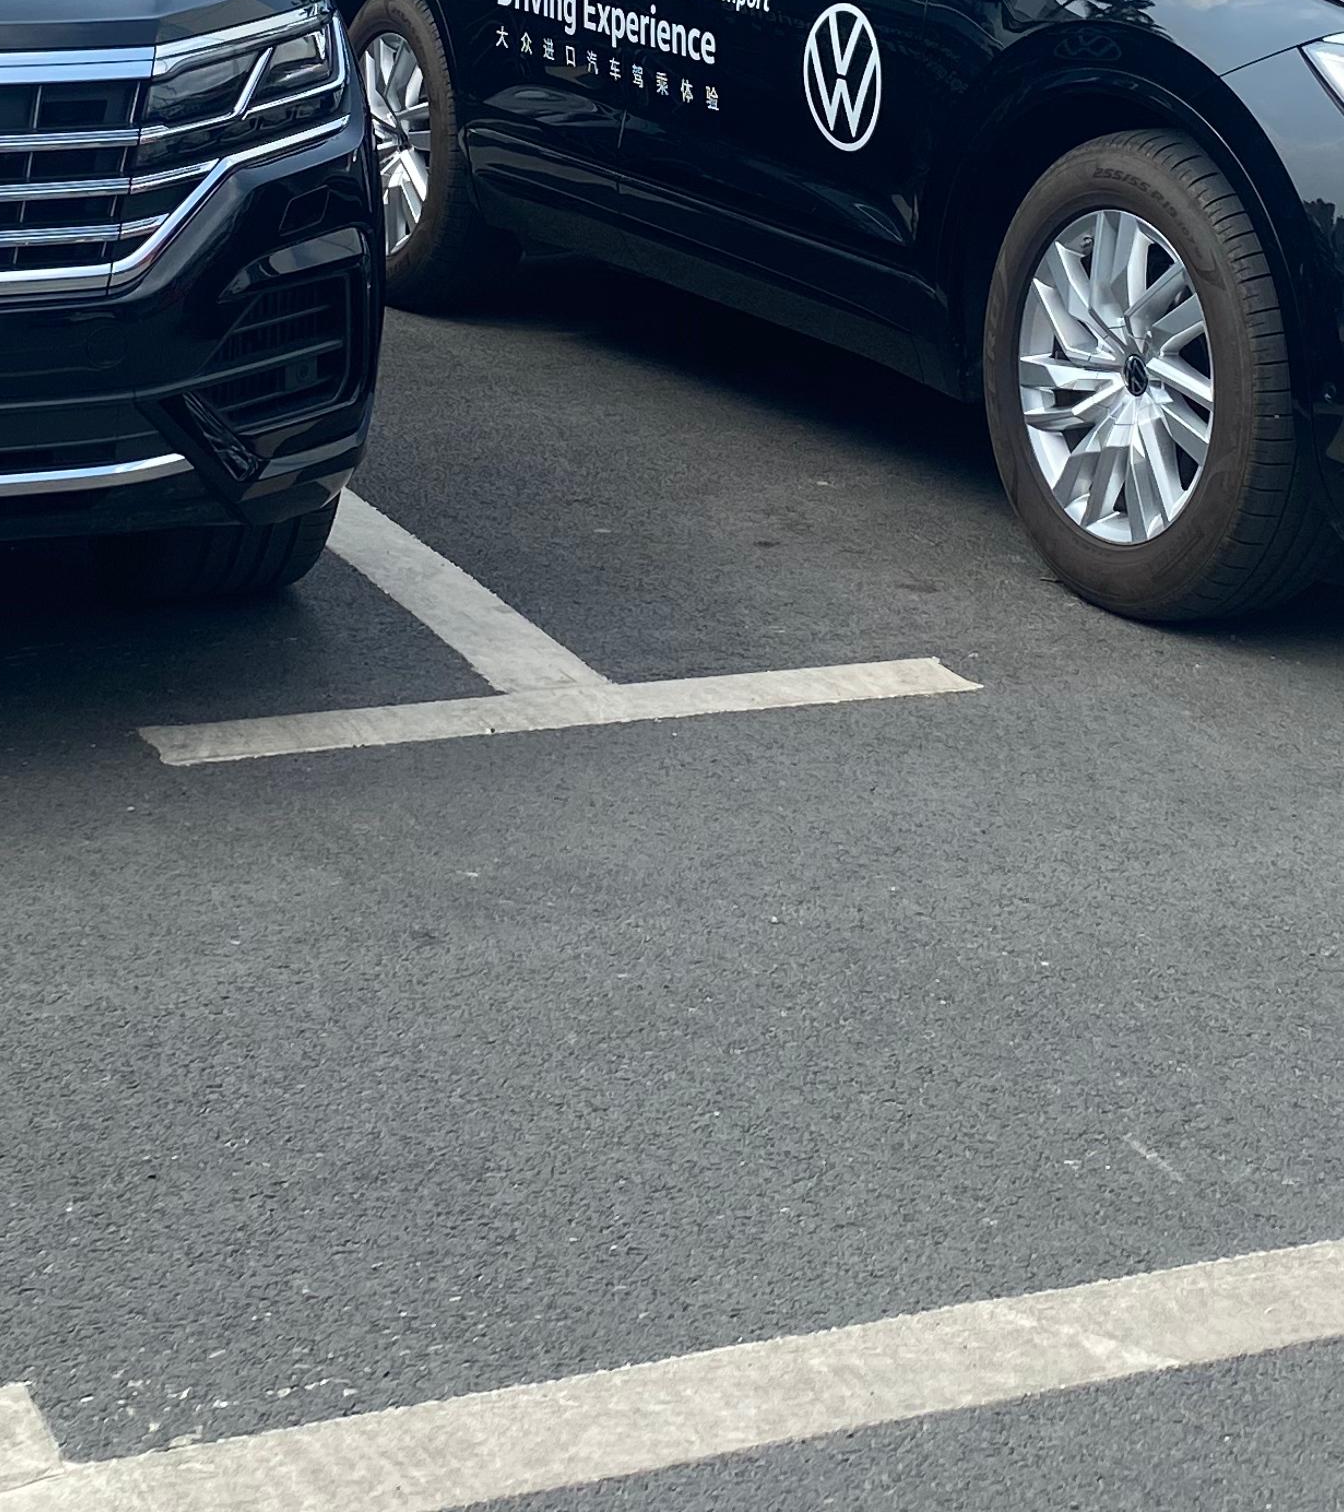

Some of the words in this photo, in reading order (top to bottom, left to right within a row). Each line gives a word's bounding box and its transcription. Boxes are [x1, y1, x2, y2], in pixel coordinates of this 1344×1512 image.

[496, 25, 720, 111] 大众进口汽车驾乘体验
